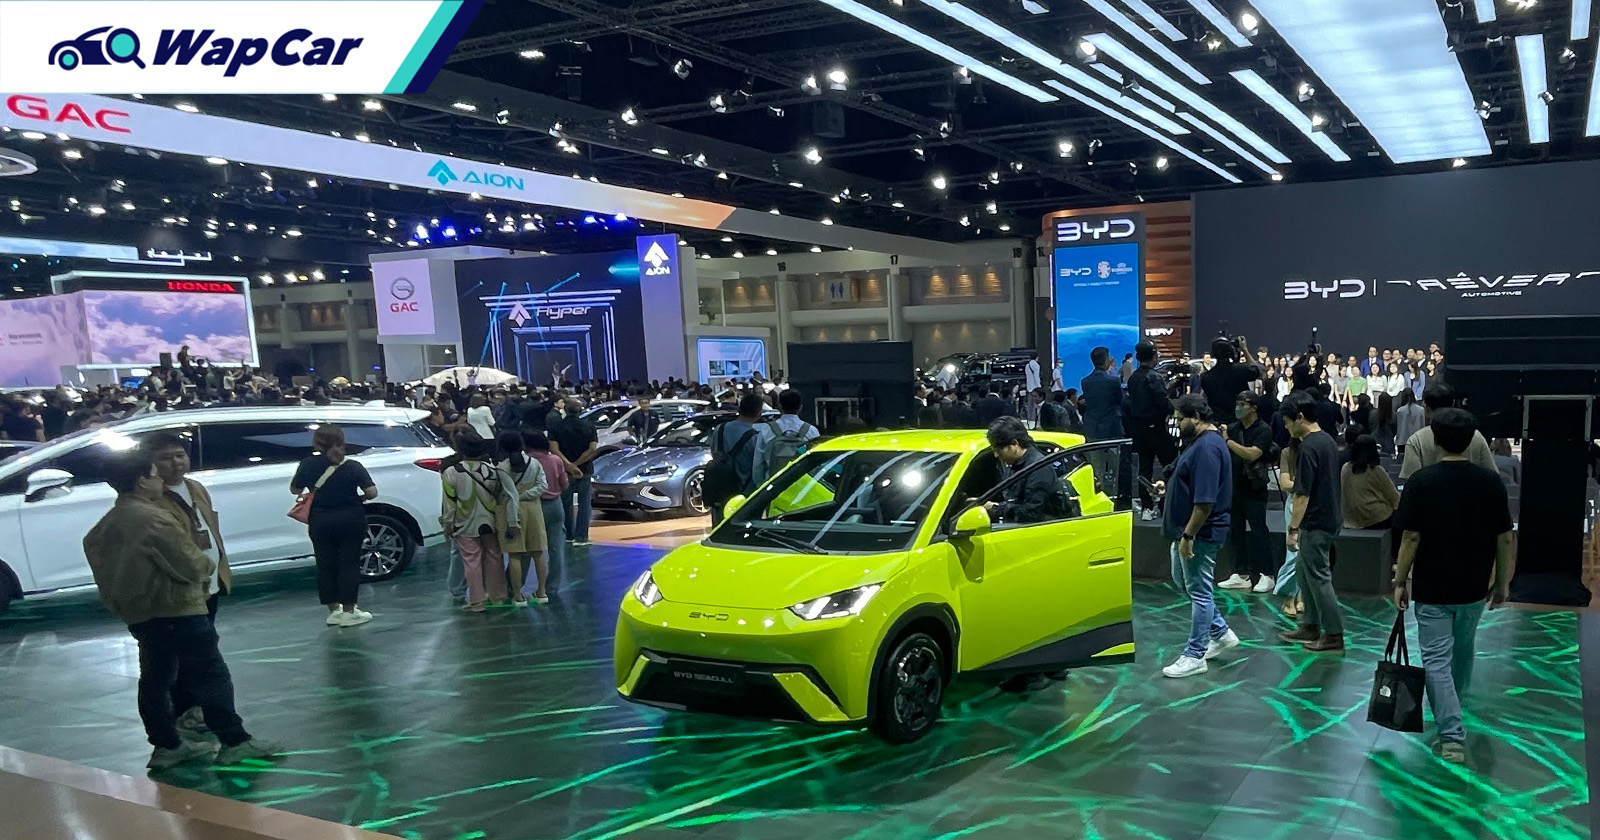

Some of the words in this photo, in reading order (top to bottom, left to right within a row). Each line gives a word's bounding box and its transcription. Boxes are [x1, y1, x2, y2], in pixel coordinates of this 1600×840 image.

[7, 95, 132, 134] GAC
[462, 170, 524, 191] AION
[1057, 218, 1135, 242] BYD
[645, 266, 671, 276] AION
[1059, 267, 1092, 277] BYD
[167, 281, 236, 292] HONDA
[1284, 279, 1365, 299] BYD
[1461, 290, 1523, 298] AUTOMOTIVE
[390, 302, 418, 313] GAC
[536, 306, 591, 320] Hyper
[688, 611, 729, 621] BYD
[674, 671, 693, 679] BYD
